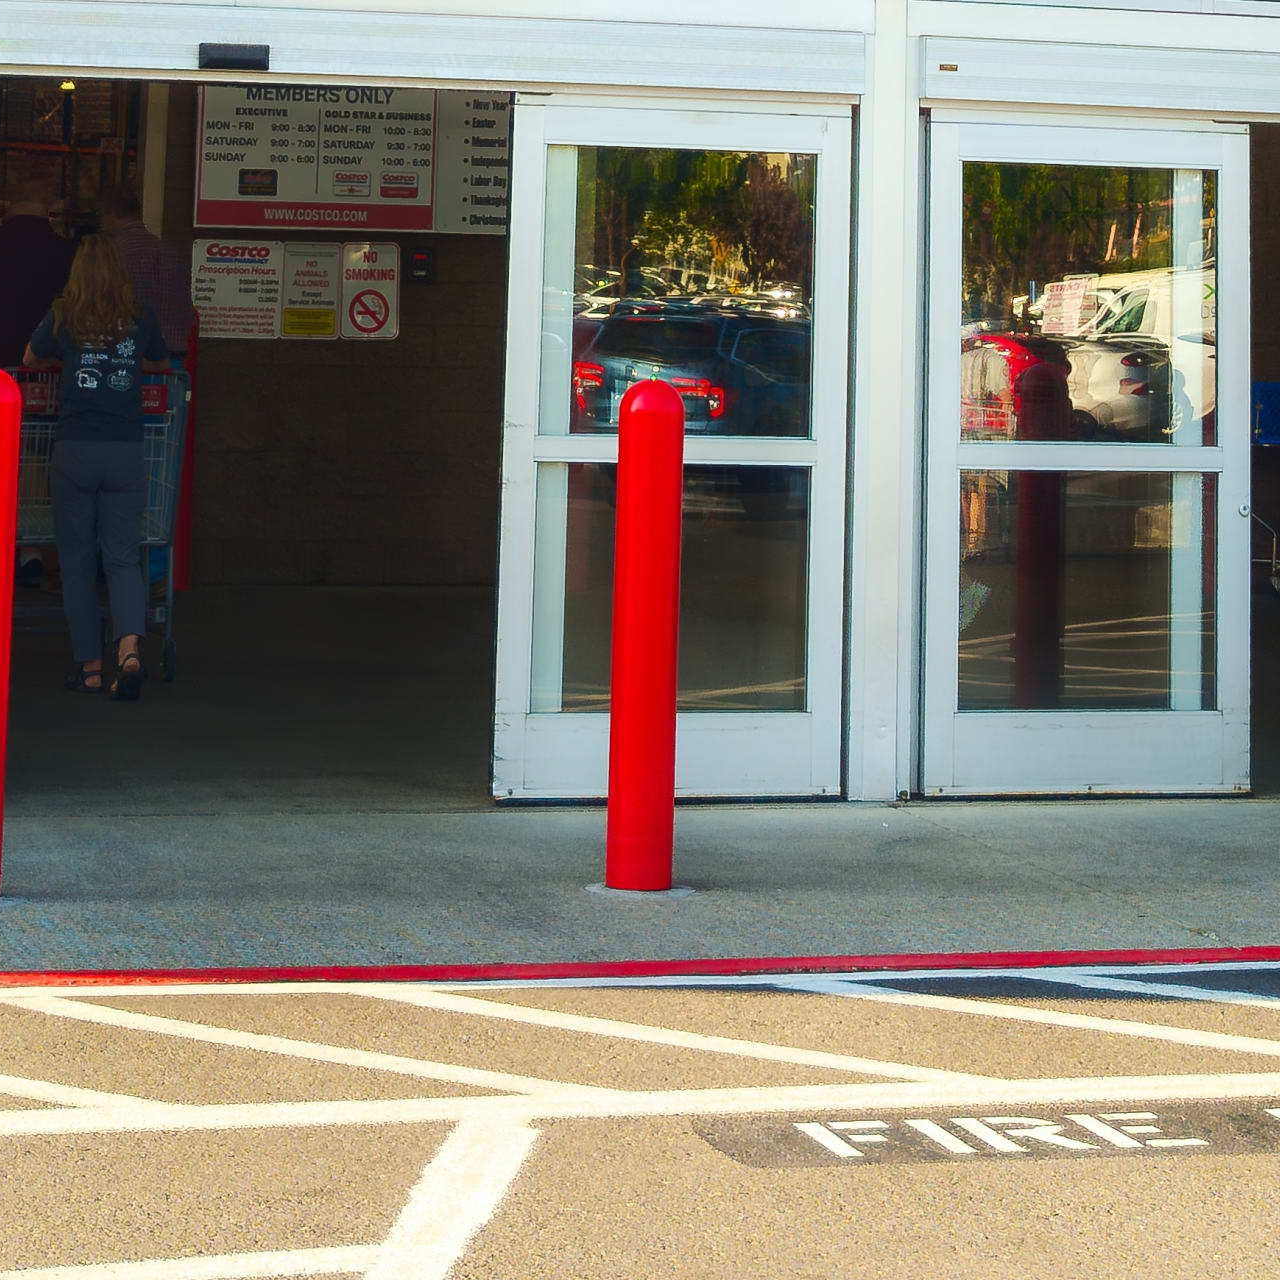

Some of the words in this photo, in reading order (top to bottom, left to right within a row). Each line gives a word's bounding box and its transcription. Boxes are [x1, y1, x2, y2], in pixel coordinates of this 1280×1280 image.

[246, 87, 340, 103] MEMBERS
[345, 89, 394, 105] ONLY
[235, 107, 288, 117] EXECUTIVE
[324, 110, 351, 119] GOLD
[352, 111, 376, 120] STAR
[378, 112, 384, 120] &
[386, 112, 432, 121] BUSINESS
[206, 120, 230, 130] MON
[238, 121, 254, 131] FRI
[323, 125, 348, 134] MON
[355, 125, 371, 134] FRI
[383, 127, 406, 136] 10:00
[413, 127, 432, 136] 8:30
[205, 136, 258, 146] SATURDAY
[297, 139, 315, 148] 7:00
[323, 139, 376, 150] SATURDAY
[413, 143, 431, 152] 7:00
[204, 151, 246, 162] SUNDAY
[322, 155, 363, 165] SUNDAY
[382, 157, 404, 166] 10:00
[382, 174, 415, 183] COSTCO
[264, 208, 367, 221] WWW.COSTCO.COM
[206, 242, 270, 258] COSTCO
[363, 251, 378, 263] NO
[306, 260, 318, 268] NO
[198, 265, 250, 276] Prescription
[251, 266, 276, 276] Hours
[295, 270, 328, 278] ANIMALS
[345, 268, 395, 281] SMOKING
[292, 279, 330, 288] ALLOWED
[302, 290, 322, 298] Except
[288, 298, 310, 306] Service
[792, 1112, 1211, 1158] FIRE
